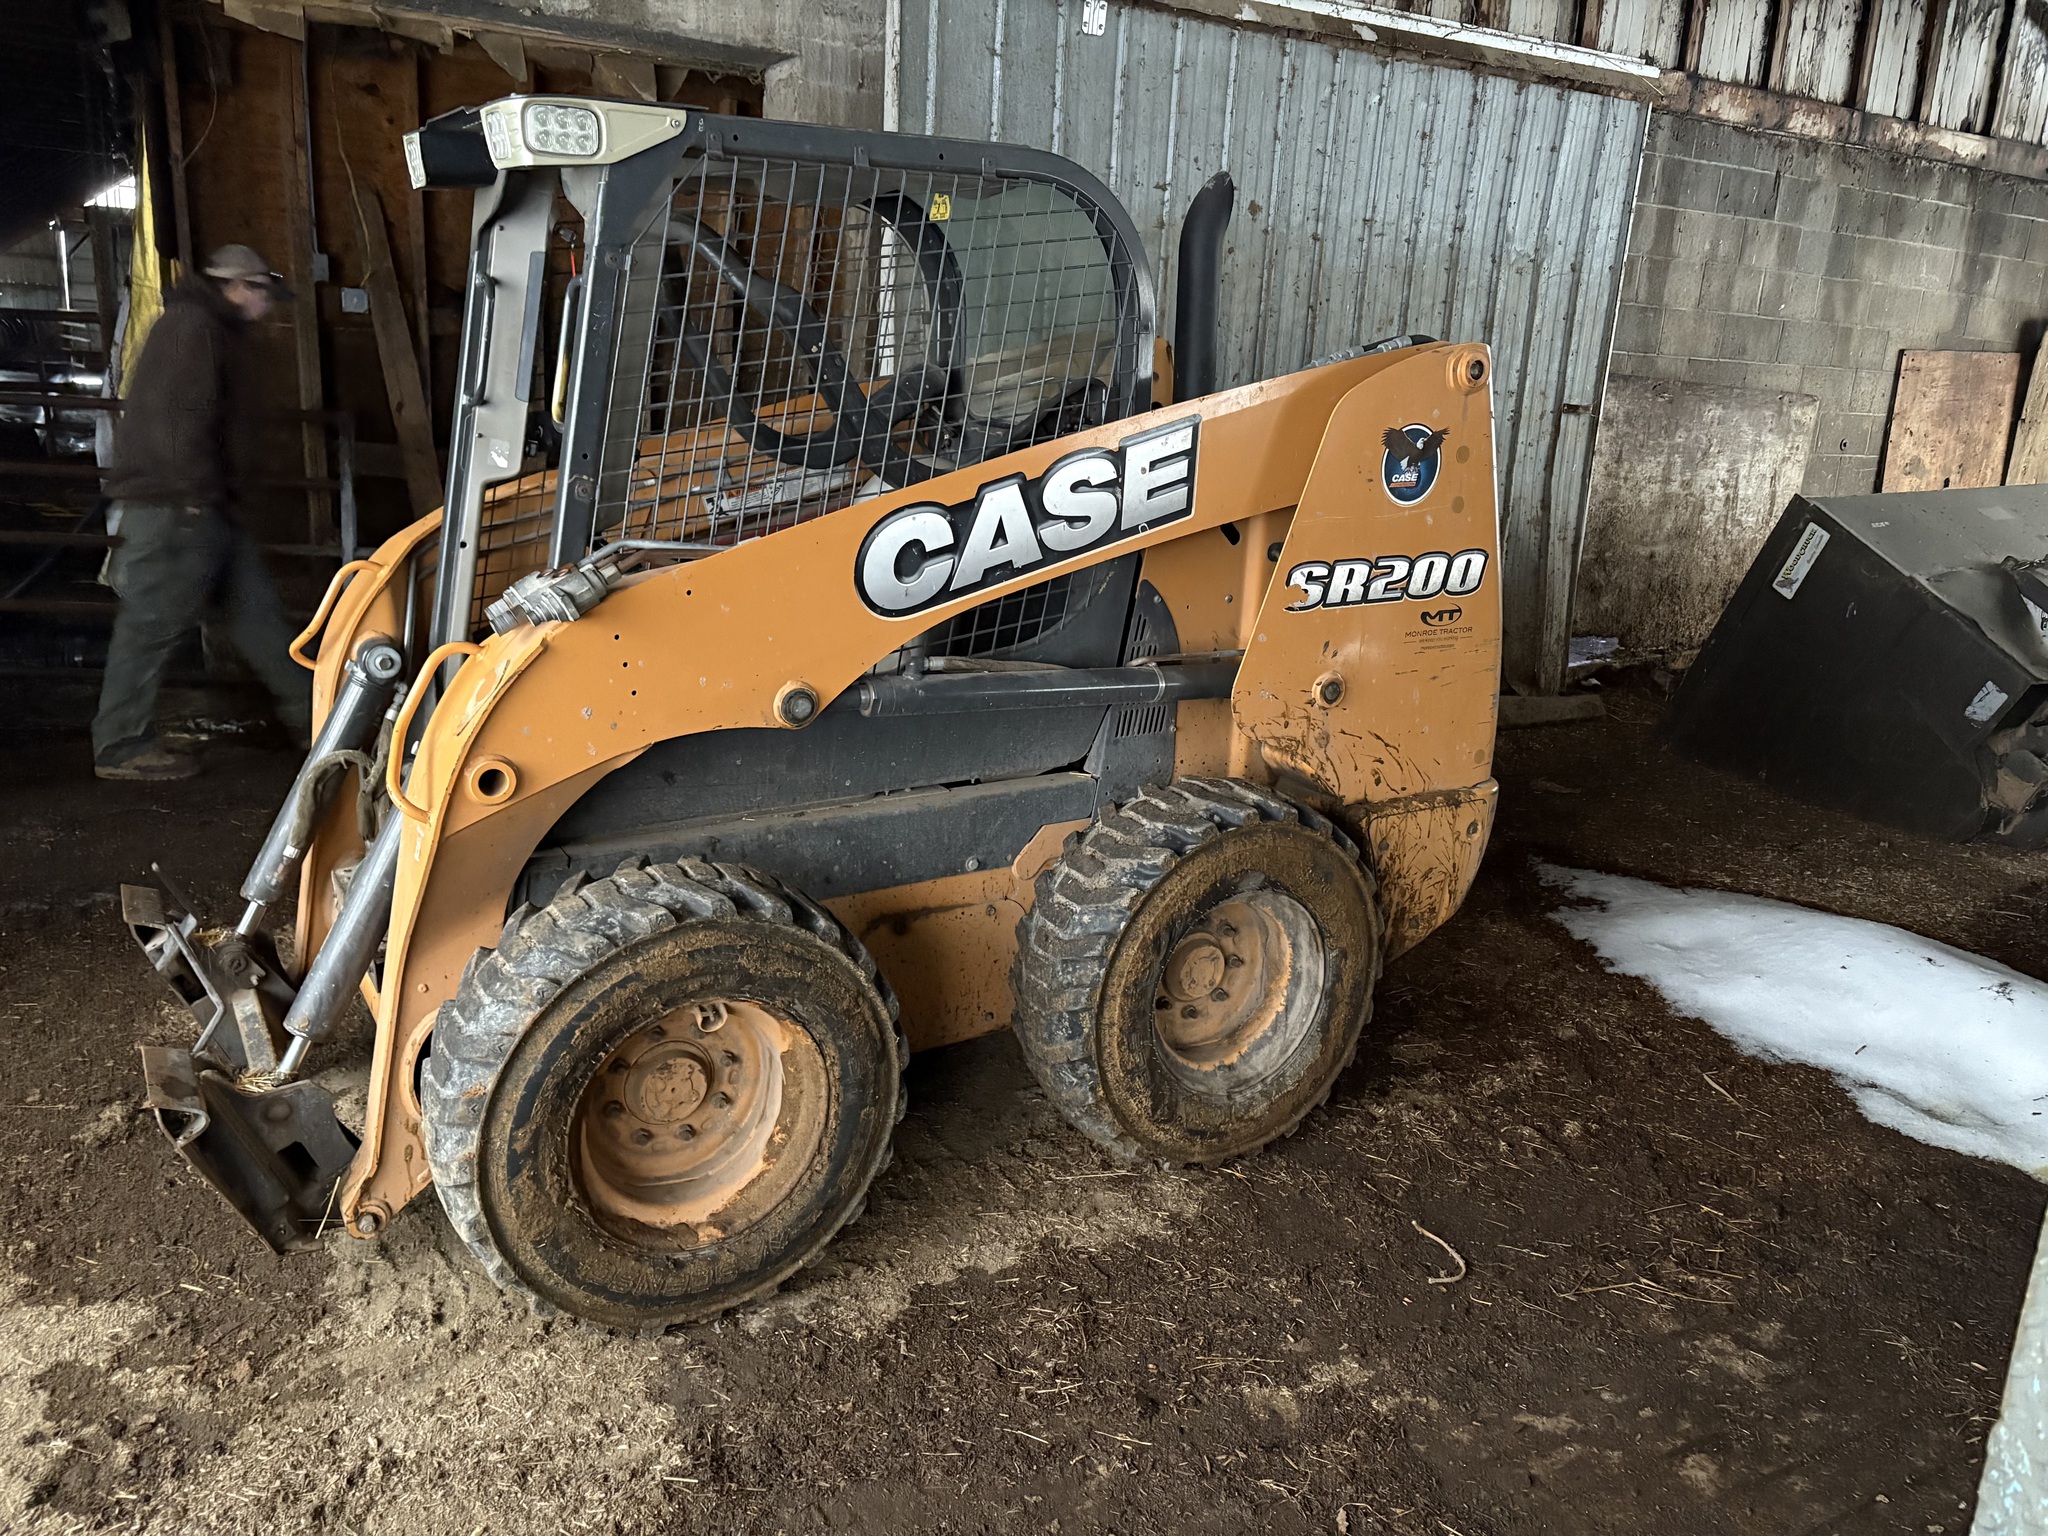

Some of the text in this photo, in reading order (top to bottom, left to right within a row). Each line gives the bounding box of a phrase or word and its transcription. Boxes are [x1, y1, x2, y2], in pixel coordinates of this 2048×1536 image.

[1391, 473, 1419, 483] CASE
[856, 416, 1200, 619] CASE
[1284, 548, 1489, 613] SR200
[1420, 606, 1462, 627] MT
[1404, 626, 1473, 638] MONROE TRACTOR
